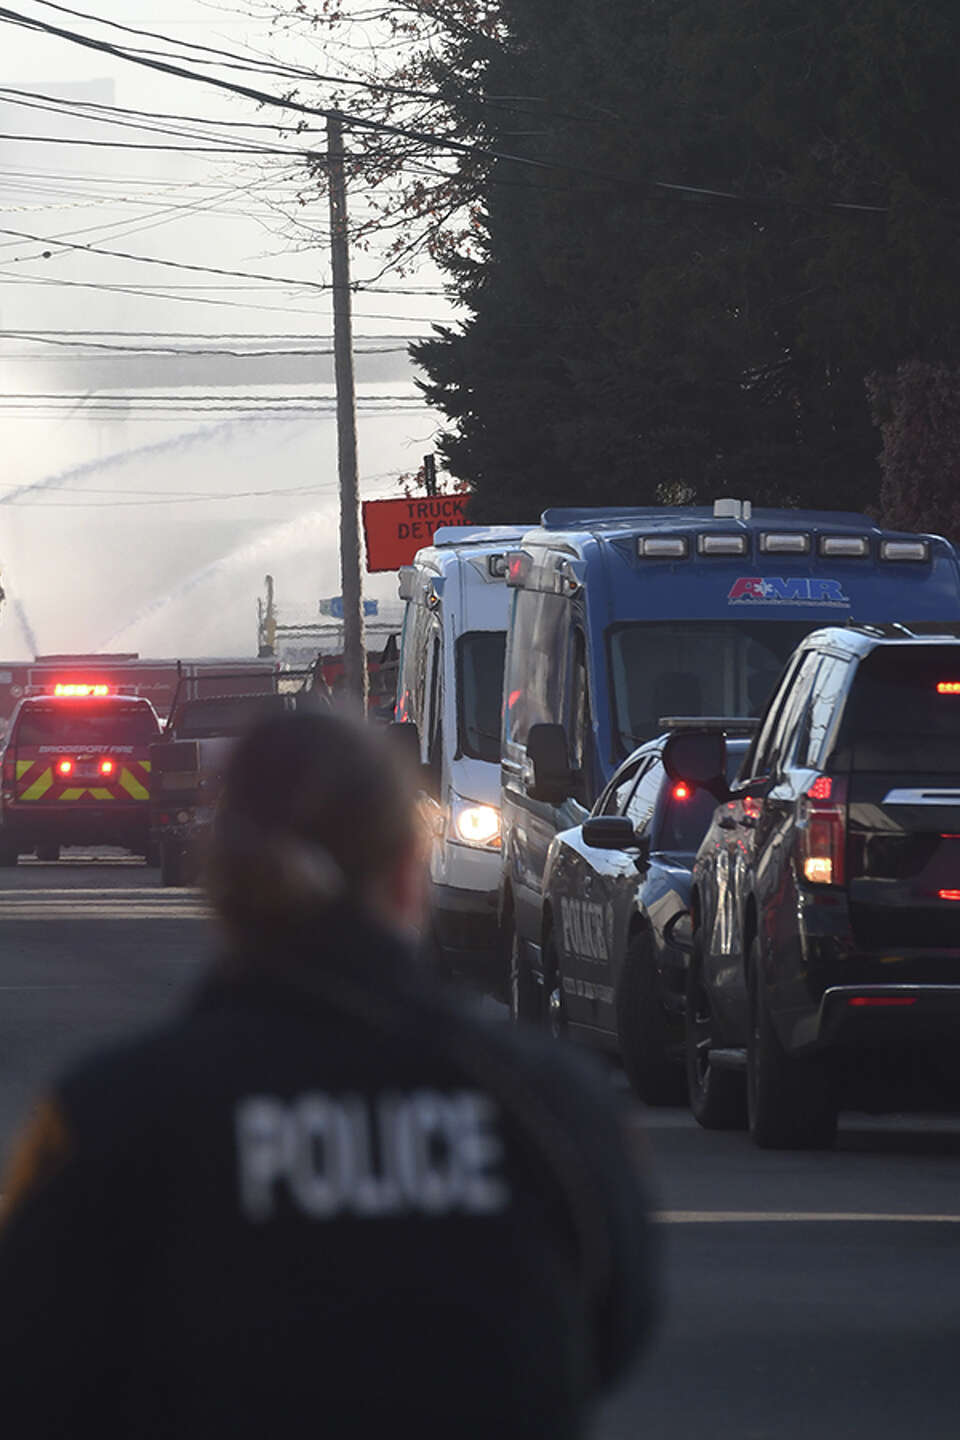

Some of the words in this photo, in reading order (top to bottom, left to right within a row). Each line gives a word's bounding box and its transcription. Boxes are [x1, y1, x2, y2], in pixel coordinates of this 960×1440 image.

[407, 501, 464, 518] TRUCK
[728, 577, 849, 601] AMR
[39, 744, 109, 753] BRIDGEPORT
[109, 744, 134, 753] FIRE
[561, 896, 609, 960] POLICE
[237, 1092, 506, 1218] POLICE
